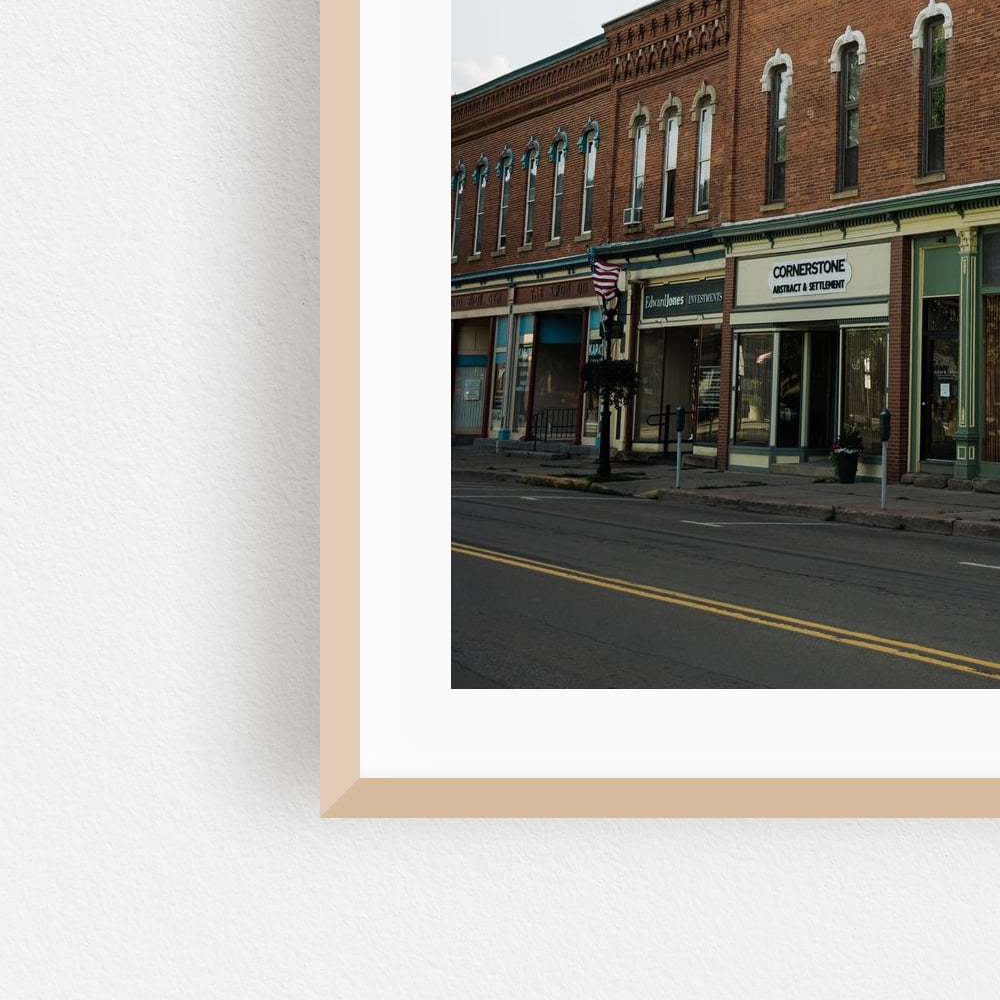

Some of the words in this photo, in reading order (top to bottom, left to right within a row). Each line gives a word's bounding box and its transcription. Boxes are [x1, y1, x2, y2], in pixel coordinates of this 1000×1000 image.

[773, 258, 846, 279] CORNERSTONE
[772, 283, 802, 294] ABSTRACT
[802, 282, 808, 292] &
[809, 279, 846, 291] SETTLEMENT
[688, 292, 723, 305] INVESTMENTS
